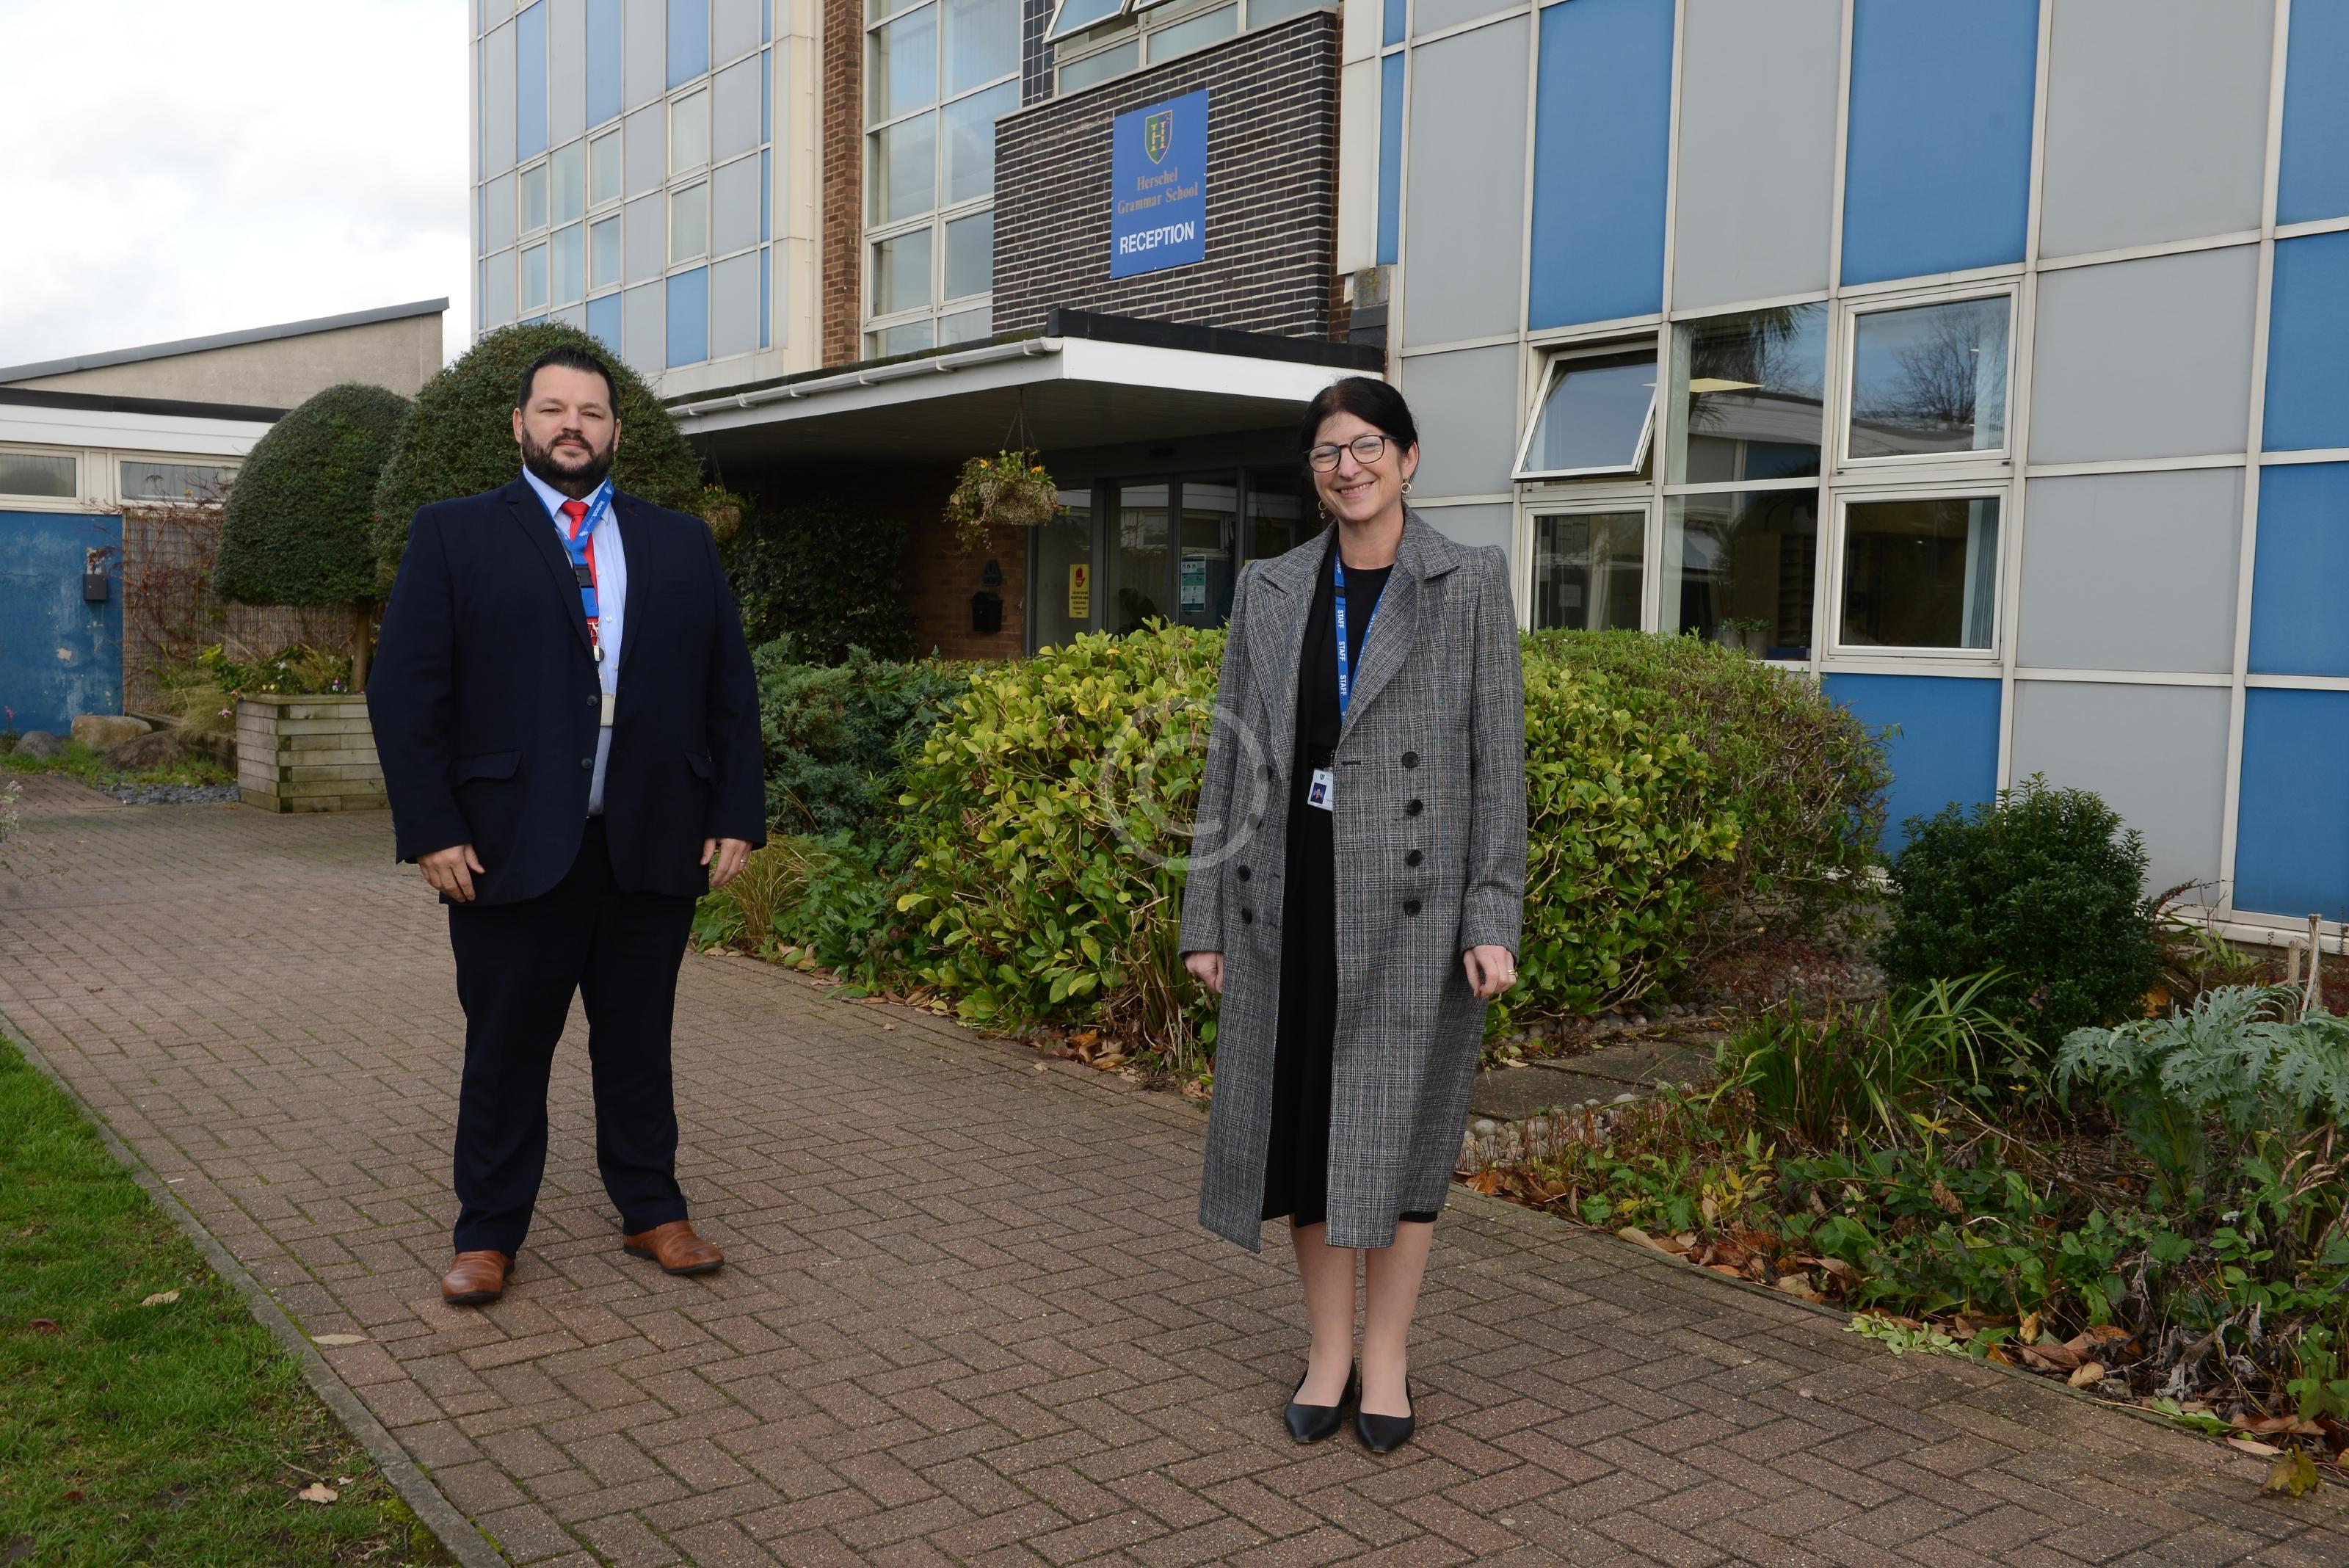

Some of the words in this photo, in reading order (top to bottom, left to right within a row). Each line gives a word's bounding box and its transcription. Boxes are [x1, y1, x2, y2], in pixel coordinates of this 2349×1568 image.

[1136, 167, 1178, 192] Herschel
[1117, 194, 1162, 214] Grammar
[1165, 181, 1199, 203] School
[1119, 220, 1194, 255] RECEPTION
